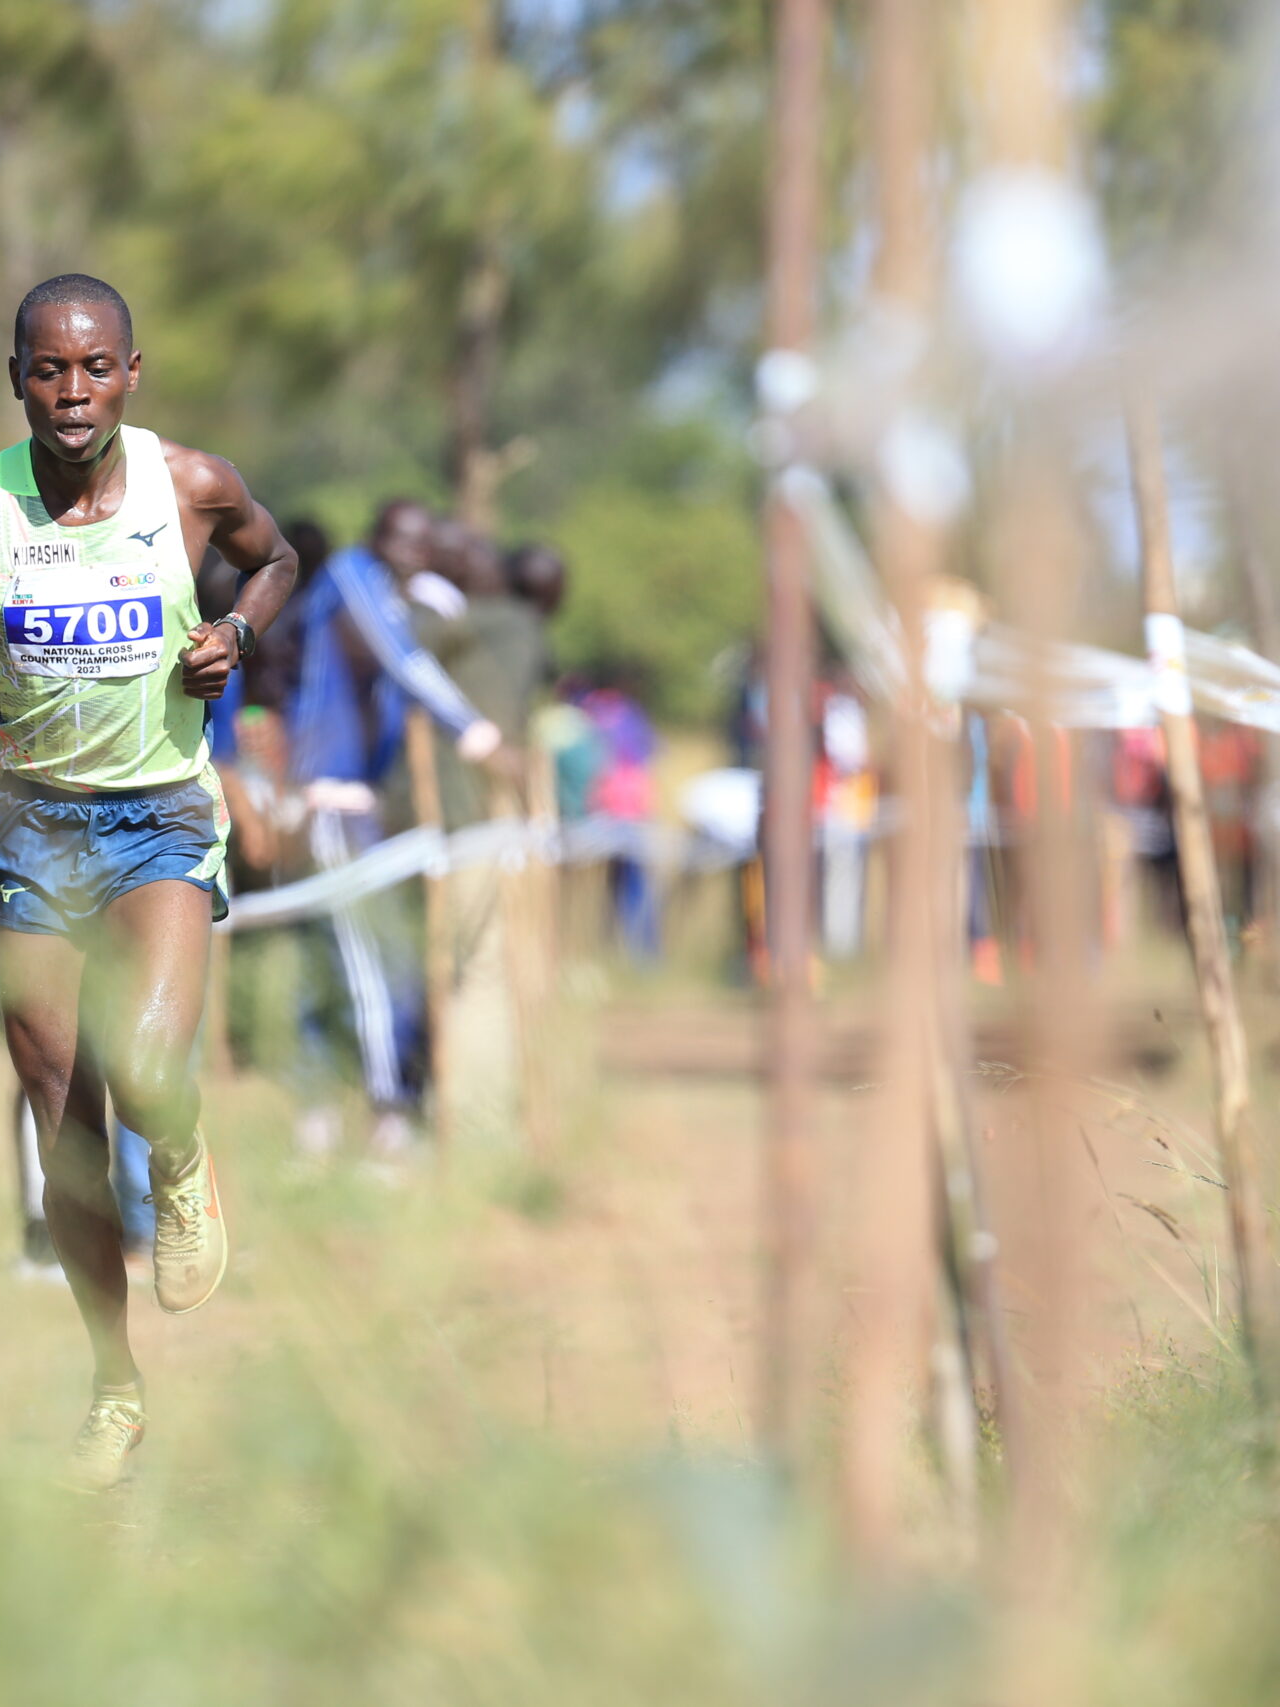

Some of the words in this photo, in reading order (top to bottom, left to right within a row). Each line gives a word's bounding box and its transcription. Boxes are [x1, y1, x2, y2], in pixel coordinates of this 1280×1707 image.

[13, 543, 75, 566] KURASHIKI
[23, 601, 149, 644] 5700
[43, 647, 95, 656] NATIONAL
[98, 644, 133, 654] CROSS
[20, 654, 69, 664] COUNTRY
[71, 651, 157, 665] CHAMPIONSHIPS
[76, 665, 101, 674] 2023
